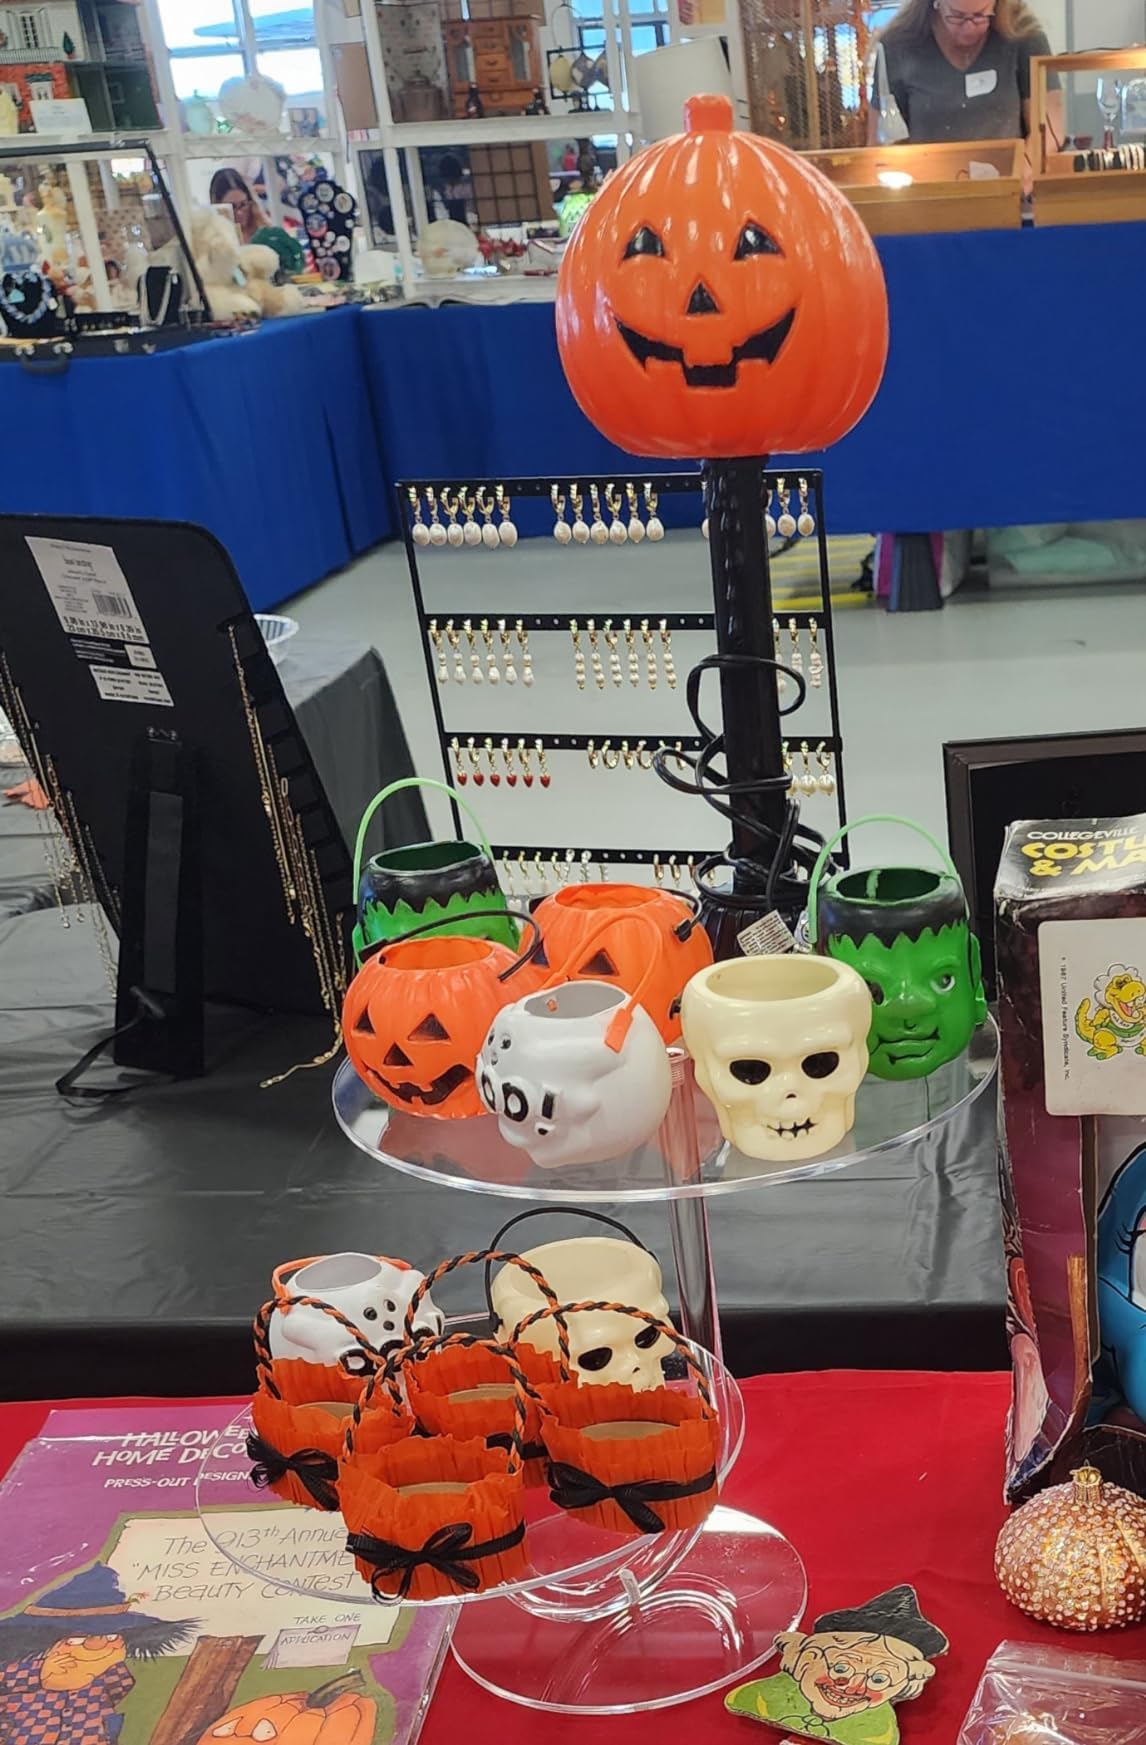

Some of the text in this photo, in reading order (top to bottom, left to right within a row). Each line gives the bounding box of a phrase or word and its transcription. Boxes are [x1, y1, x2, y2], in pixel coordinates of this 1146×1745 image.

[1027, 827, 1137, 840] COLLEGEVILLE
[1029, 860, 1062, 877] &
[1060, 982, 1068, 1005] United
[1061, 1006, 1069, 1032] Feature
[1061, 1033, 1070, 1068] Syndicate,
[92, 1442, 249, 1466] HOME DECO
[104, 1471, 252, 1488] PRESS-OUT DESIGN
[164, 1535, 208, 1556] The
[215, 1525, 279, 1554] 913th
[293, 1612, 361, 1625] TAKE ONE
[280, 1632, 351, 1645] APPLICATION
